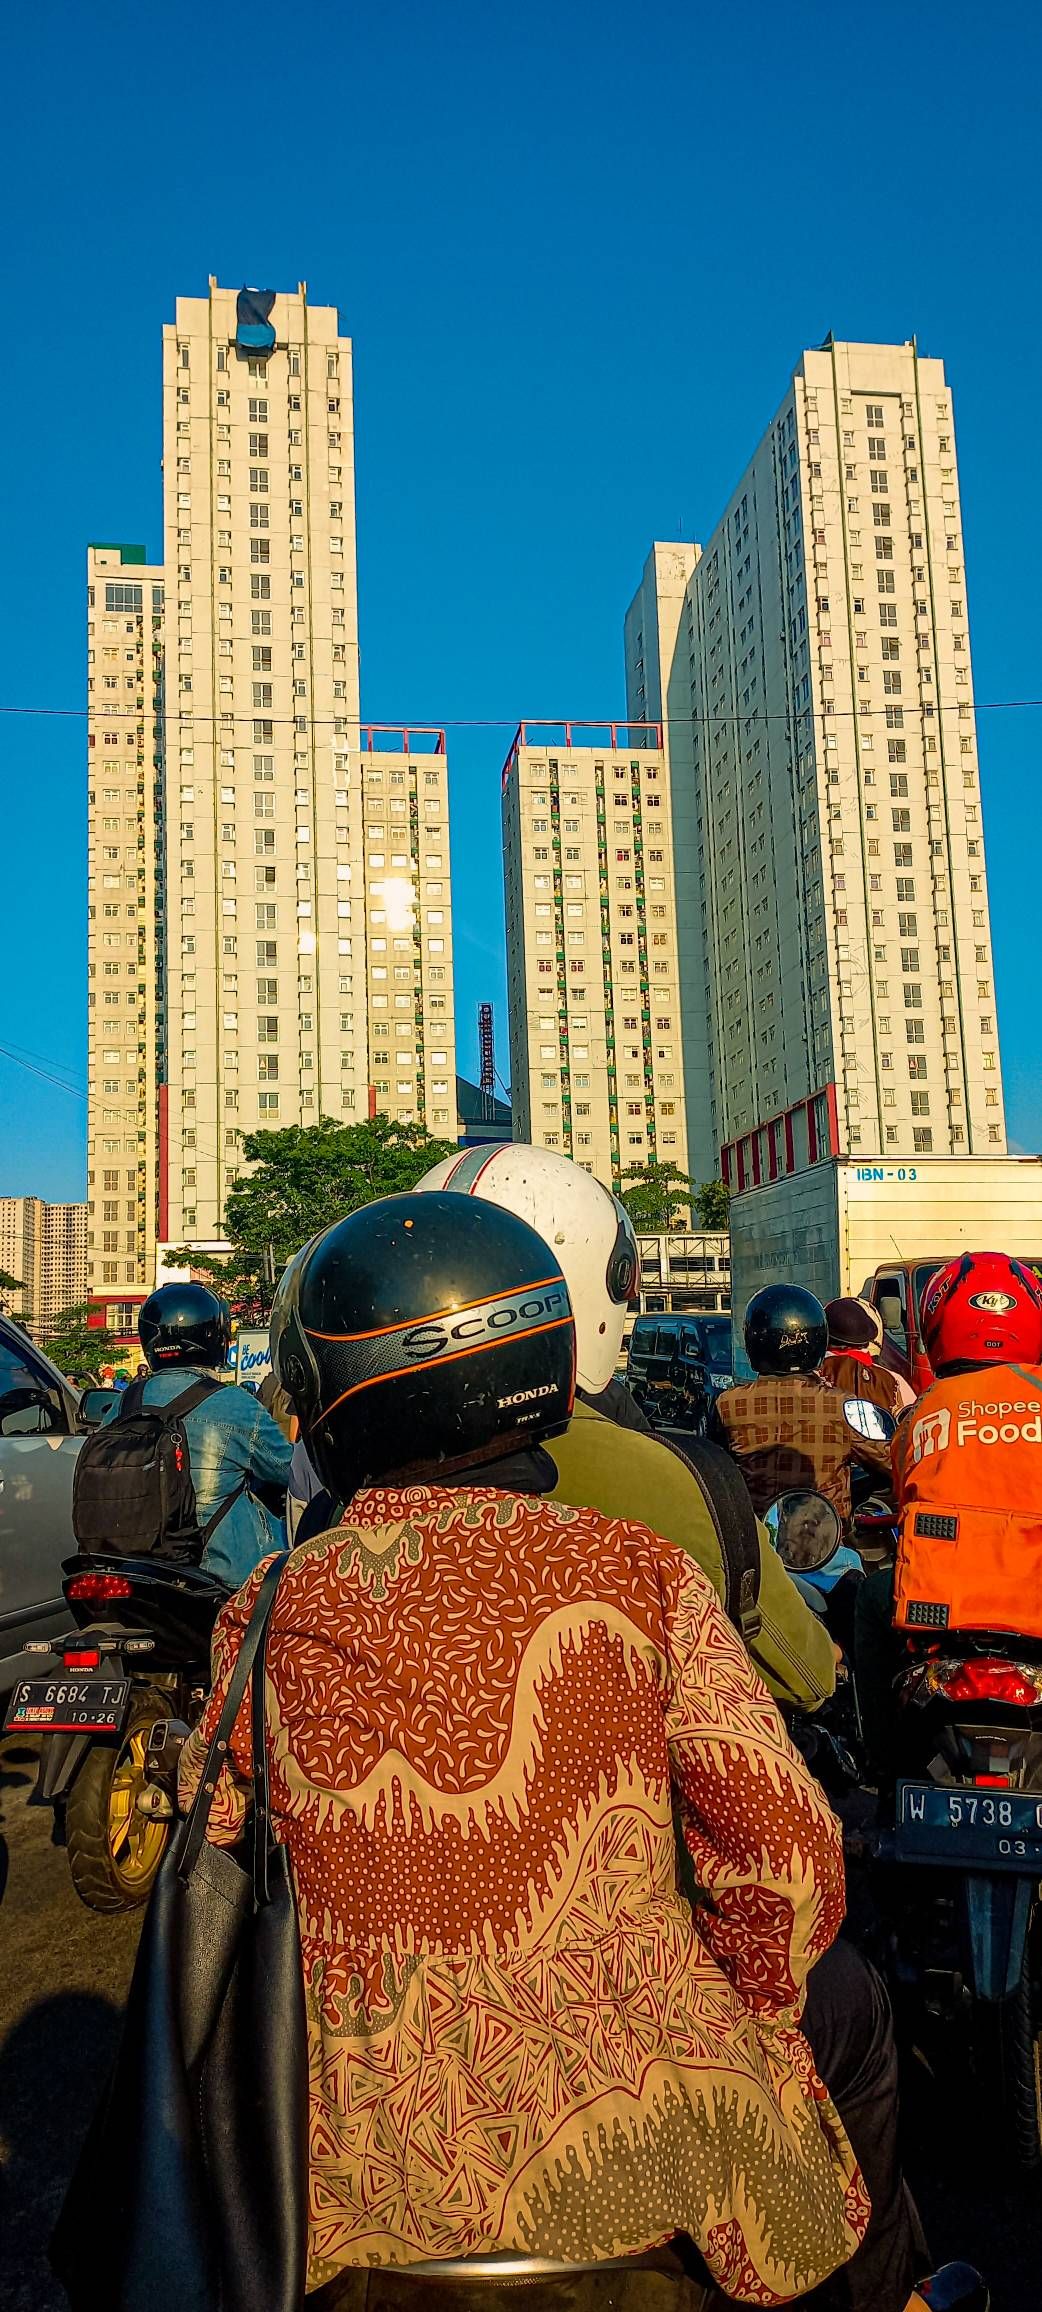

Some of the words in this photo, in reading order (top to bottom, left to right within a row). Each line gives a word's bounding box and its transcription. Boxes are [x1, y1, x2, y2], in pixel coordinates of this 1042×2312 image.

[402, 1290, 569, 1358] SCOOP
[154, 1344, 182, 1353] HONDA
[498, 1383, 559, 1409] HONDA
[958, 1400, 1041, 1420] Shopee
[957, 1416, 1042, 1447] Food
[20, 1685, 31, 1702] S
[45, 1686, 89, 1704] 6684
[103, 1686, 124, 1704] TJ
[910, 1793, 925, 1820] W
[949, 1797, 1012, 1826] 5738
